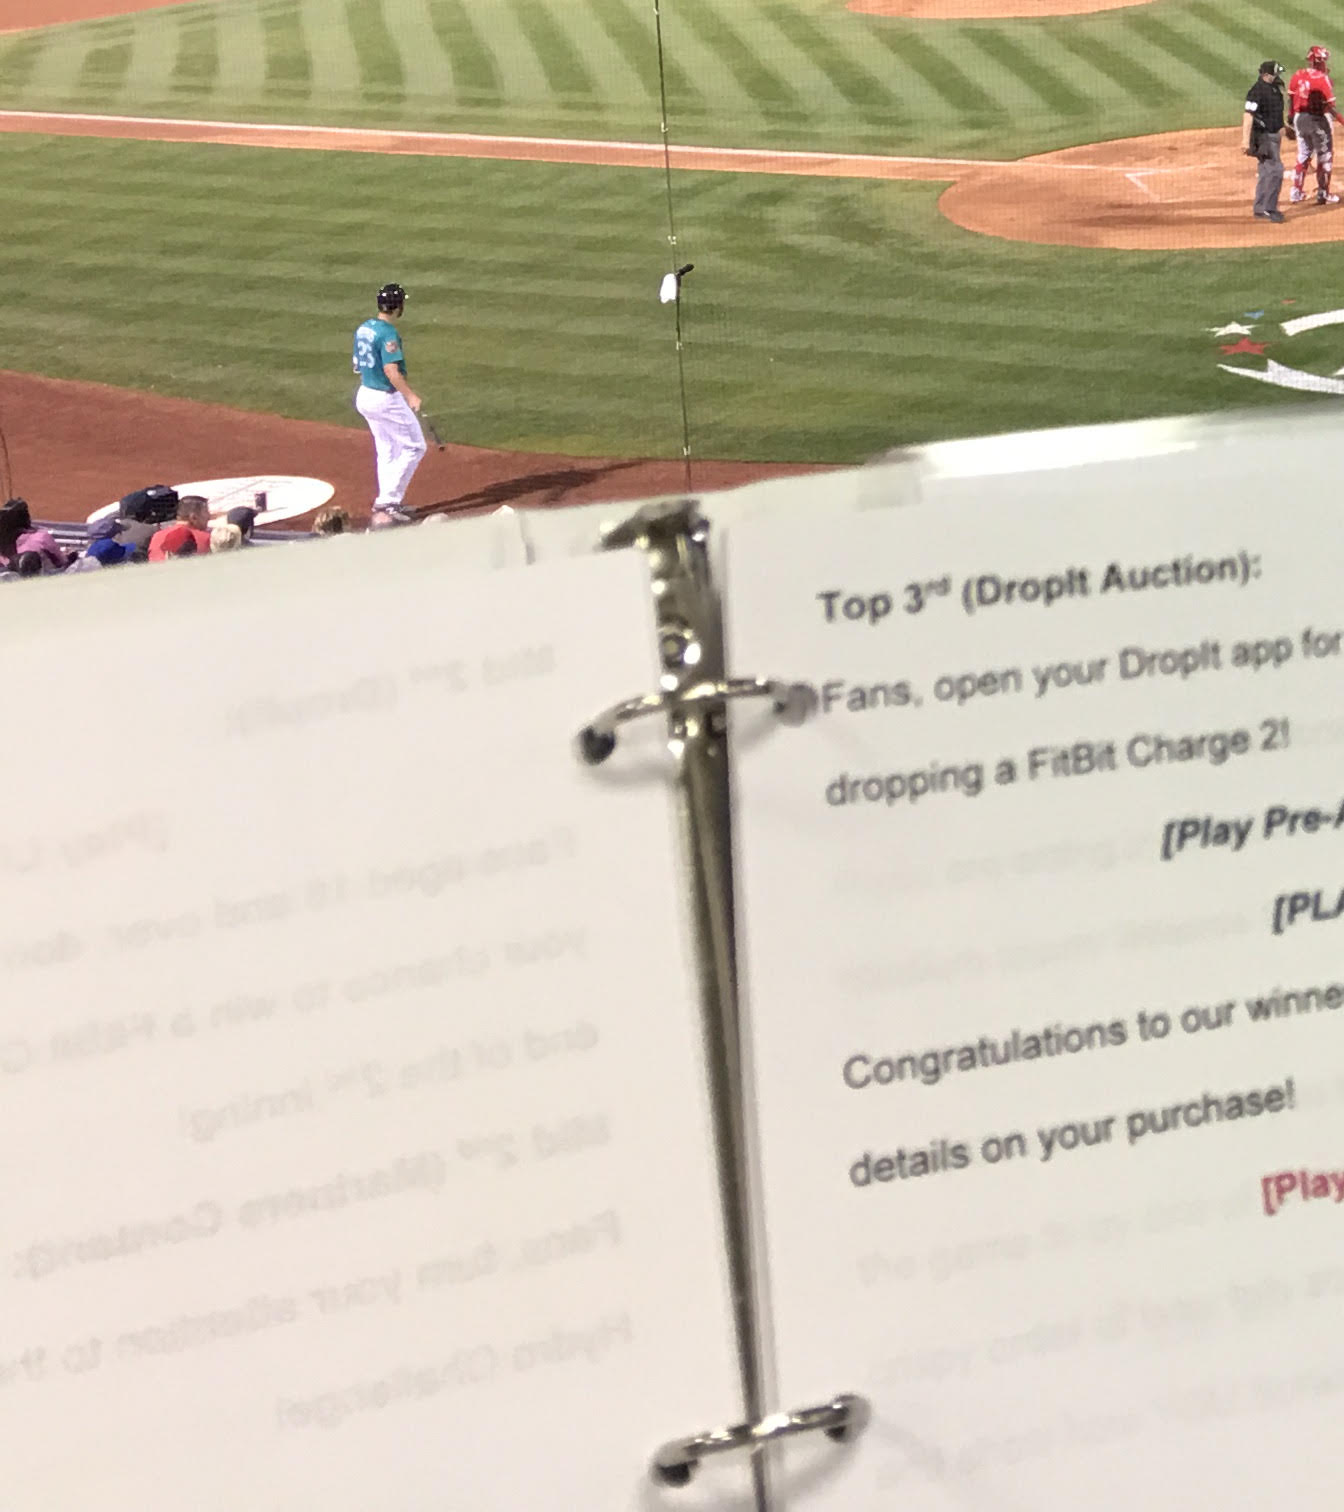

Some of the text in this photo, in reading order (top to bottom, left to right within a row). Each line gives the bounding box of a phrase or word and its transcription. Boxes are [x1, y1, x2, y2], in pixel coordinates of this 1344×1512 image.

[816, 549, 1262, 624] Top 3rd (DropIt Auction):
[821, 678, 923, 714] Fans,
[934, 664, 1023, 706] open
[1032, 656, 1108, 698] your
[1118, 639, 1222, 680] DropIt
[1231, 634, 1293, 669] app
[1301, 624, 1344, 658] for
[825, 716, 1291, 807] dropping a FitBit Charge 2!
[1160, 816, 1253, 862] [Play
[841, 1016, 1128, 1090] Congratulations
[1136, 1010, 1172, 1043] to
[1180, 1001, 1239, 1035] our
[848, 1076, 1298, 1188] details on your purchase!
